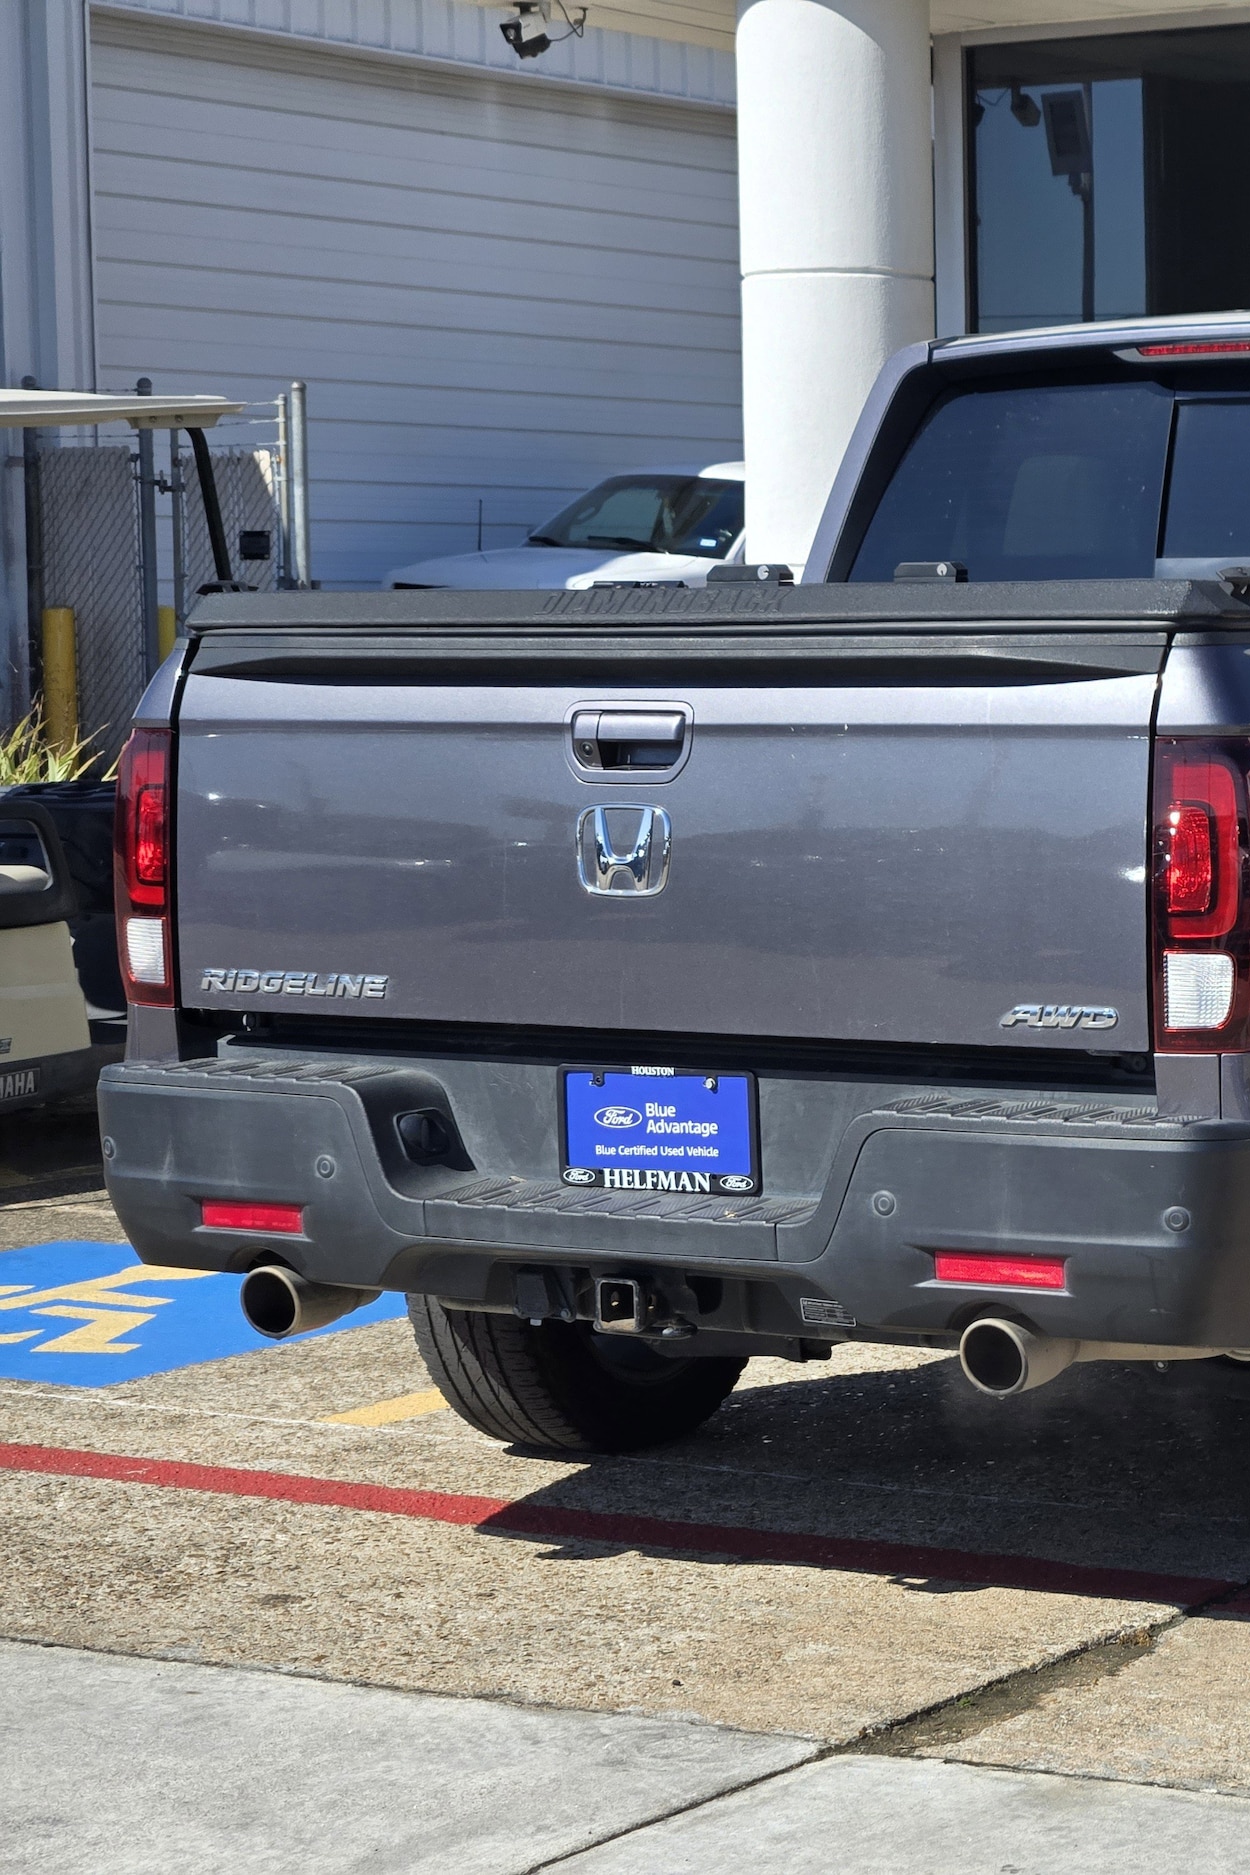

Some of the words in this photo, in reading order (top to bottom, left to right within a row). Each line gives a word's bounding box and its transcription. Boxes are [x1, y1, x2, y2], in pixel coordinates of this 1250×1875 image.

[534, 588, 792, 615] DIAMONDBACK
[201, 968, 389, 999] RIDGELINE
[1000, 1004, 1118, 1029] AWD
[631, 1066, 675, 1076] HOUSTON
[601, 1108, 635, 1126] Ford
[645, 1102, 676, 1117] Blue
[646, 1119, 718, 1137] Advantage
[595, 1144, 617, 1156] Blue
[618, 1145, 658, 1156] Certified
[660, 1145, 684, 1157] Used
[687, 1146, 719, 1157] Vehicle
[567, 1169, 591, 1183] Ford
[602, 1168, 711, 1192] HELFMAN
[724, 1176, 750, 1190] Ford
